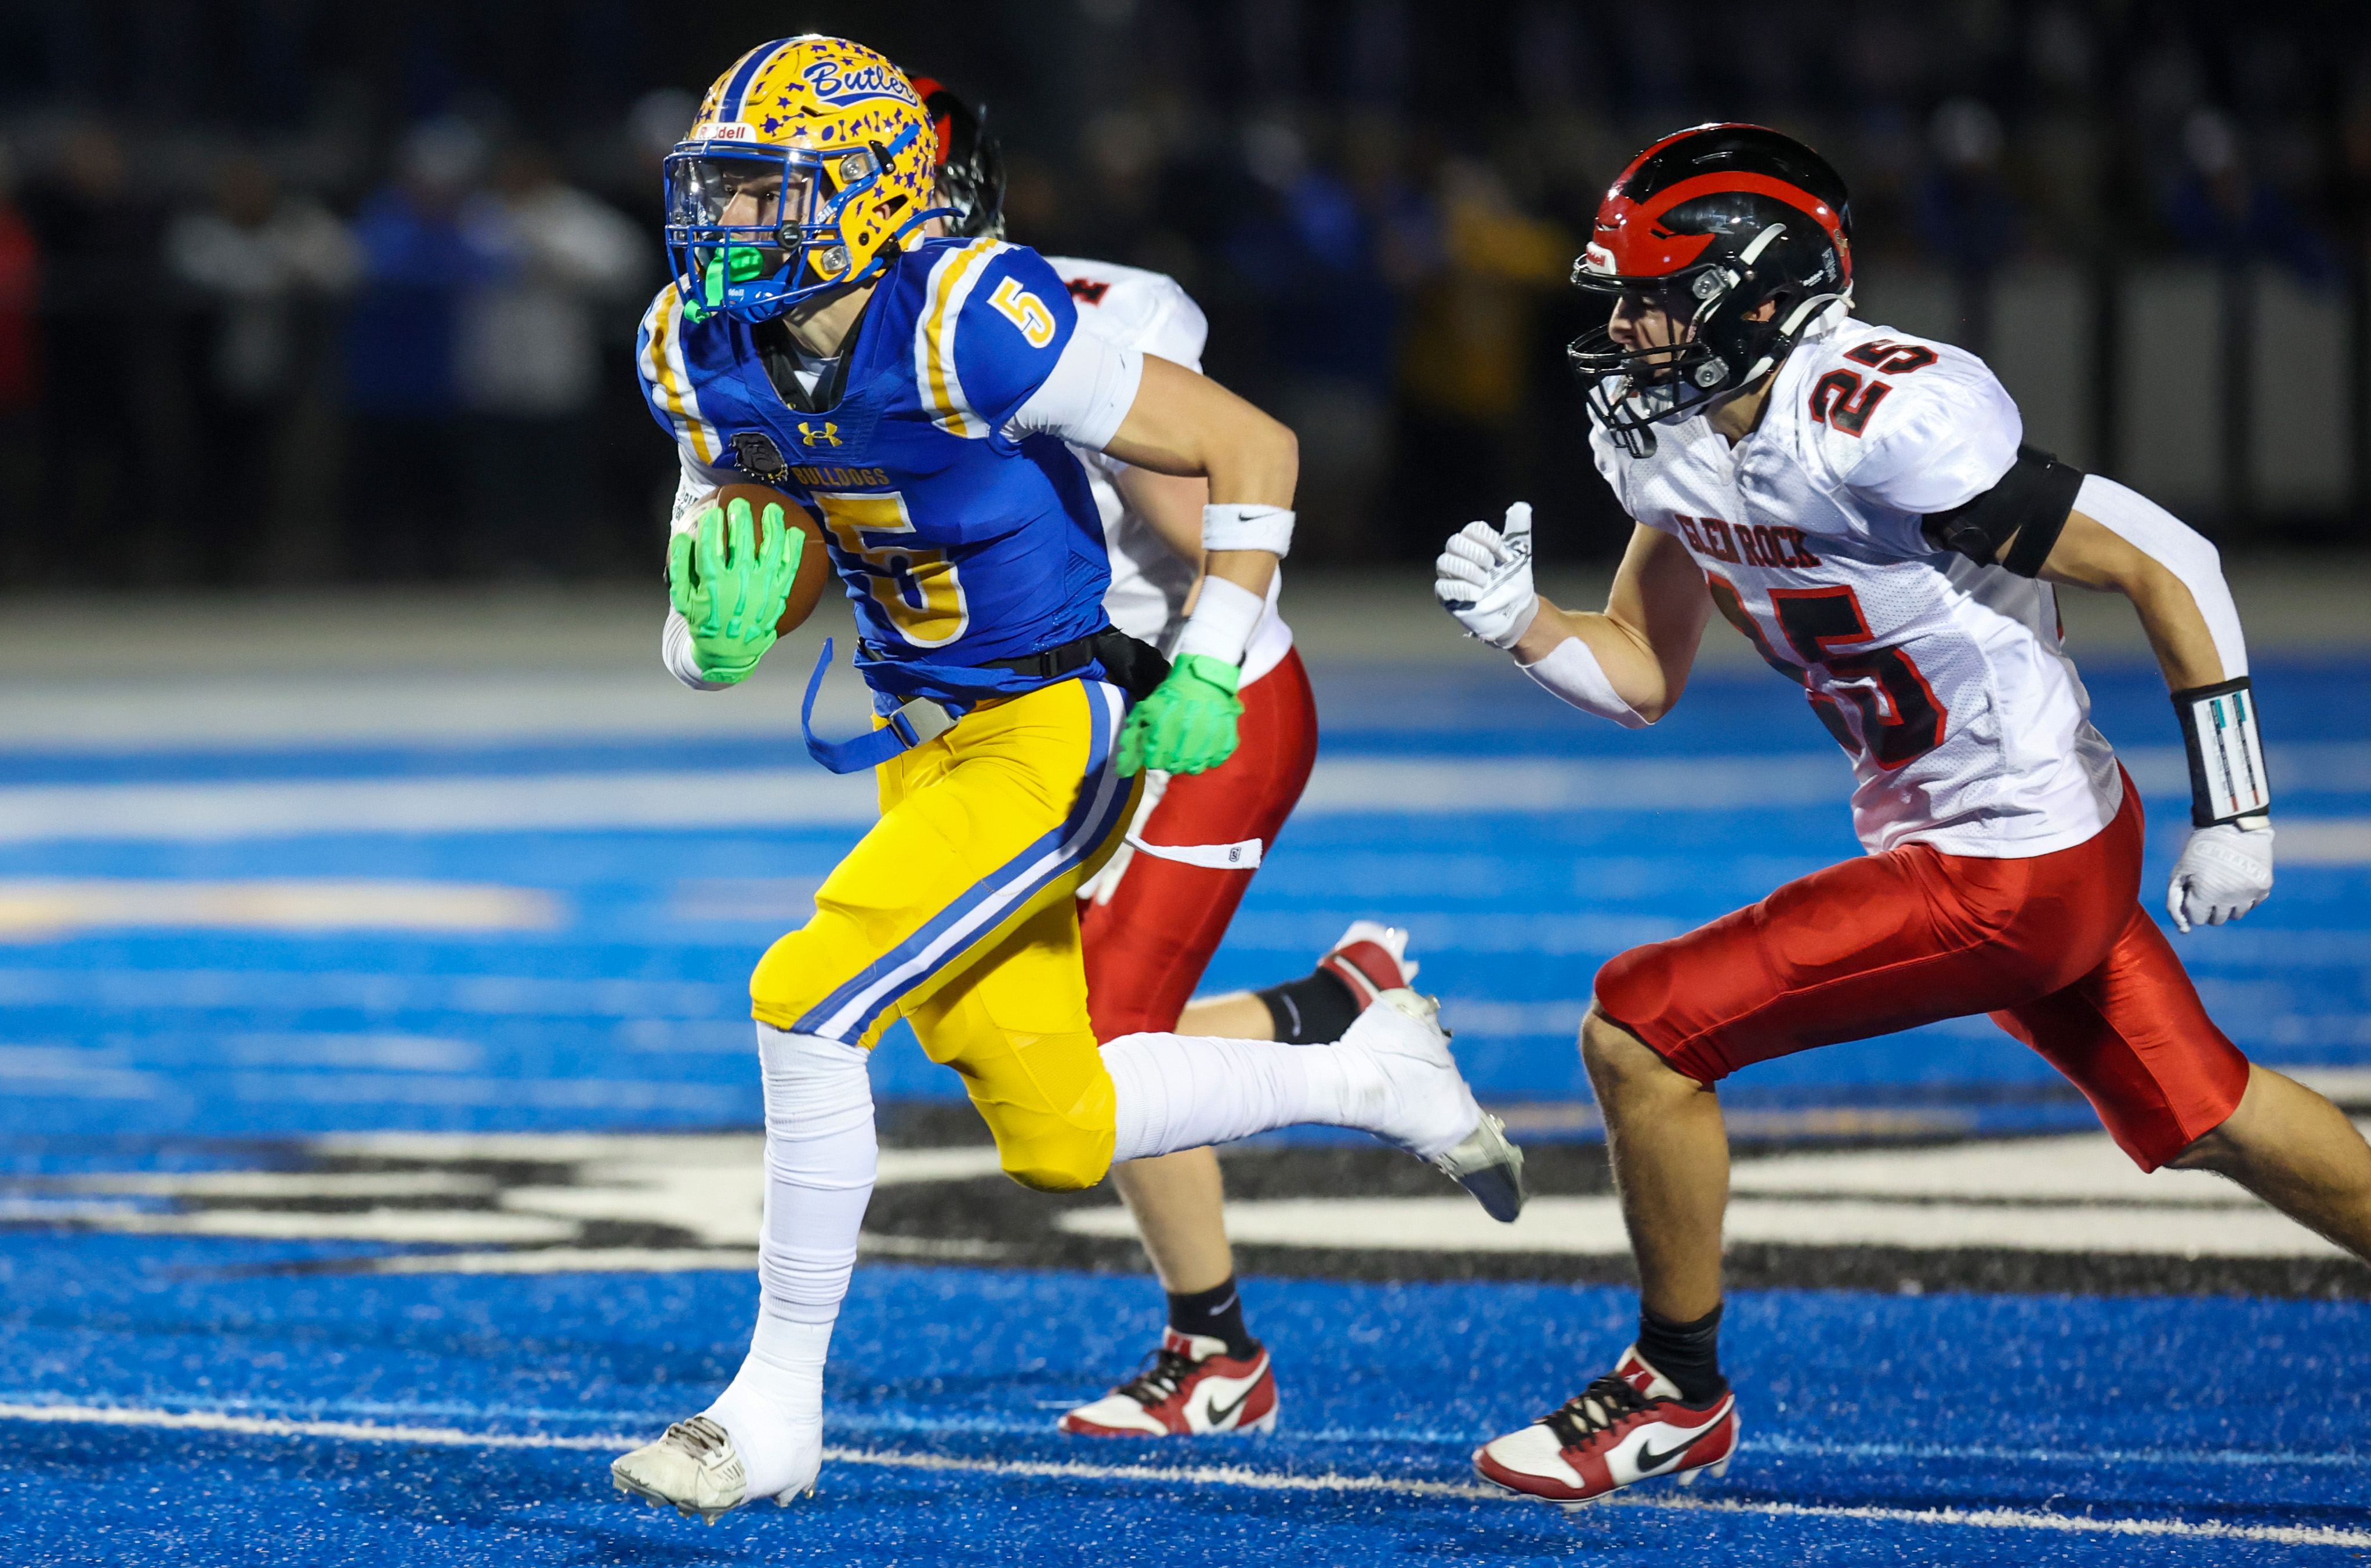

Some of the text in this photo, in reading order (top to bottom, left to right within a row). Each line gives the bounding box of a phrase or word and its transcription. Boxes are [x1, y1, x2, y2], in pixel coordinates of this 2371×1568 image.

[802, 61, 915, 102] Butler
[699, 126, 745, 139] Rdell
[987, 275, 1057, 349] 5
[1808, 339, 1939, 438] 25
[791, 467, 890, 487] BULLDOGS
[1733, 523, 1822, 568] ROCK
[812, 491, 970, 648] 5
